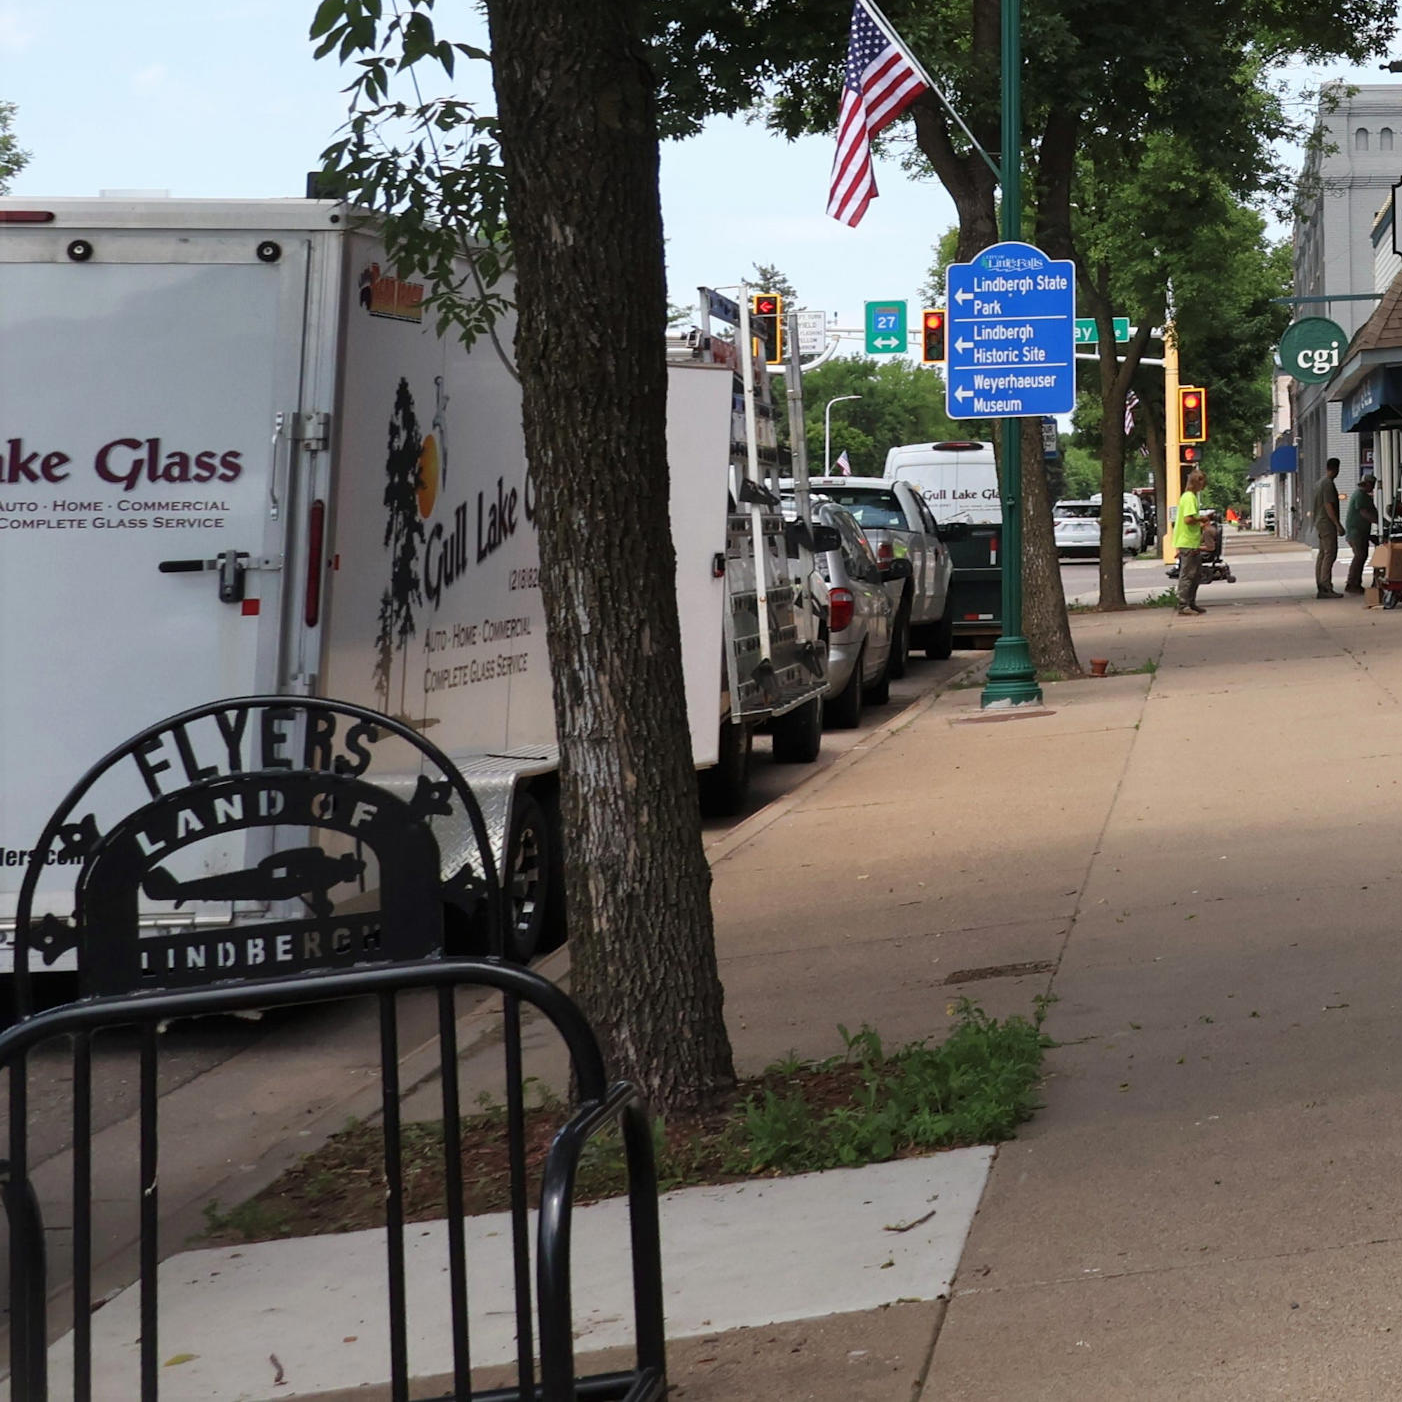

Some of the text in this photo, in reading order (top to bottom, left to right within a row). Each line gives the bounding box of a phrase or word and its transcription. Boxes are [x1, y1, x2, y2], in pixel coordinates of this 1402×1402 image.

[1017, 257, 1043, 268] Falls
[973, 275, 1067, 295] Lindbergh State
[973, 300, 1002, 315] Park
[877, 316, 896, 329] 27
[973, 324, 1033, 343] Lindbergh
[973, 346, 1045, 363] Historic Site
[1297, 341, 1339, 374] cgi
[973, 374, 1056, 394] Weyerhaeuser
[973, 399, 1022, 413] Museum
[94, 437, 243, 491] Glass
[922, 489, 1001, 501] Gull Lake Gla
[53, 500, 103, 512] HOME
[117, 499, 230, 512] COMMERCIAL
[0, 516, 224, 530] COMPLETE GLASS SERVICE
[424, 501, 467, 612] Gull
[476, 476, 518, 565] Lake
[422, 616, 532, 654] AUTO HOME COMMERCIAL
[424, 653, 528, 694] COMPLETE GLASS SERVICE
[133, 707, 378, 798] FLYERS
[137, 789, 378, 857] LAND OF
[140, 923, 382, 978] LINDBERGH
